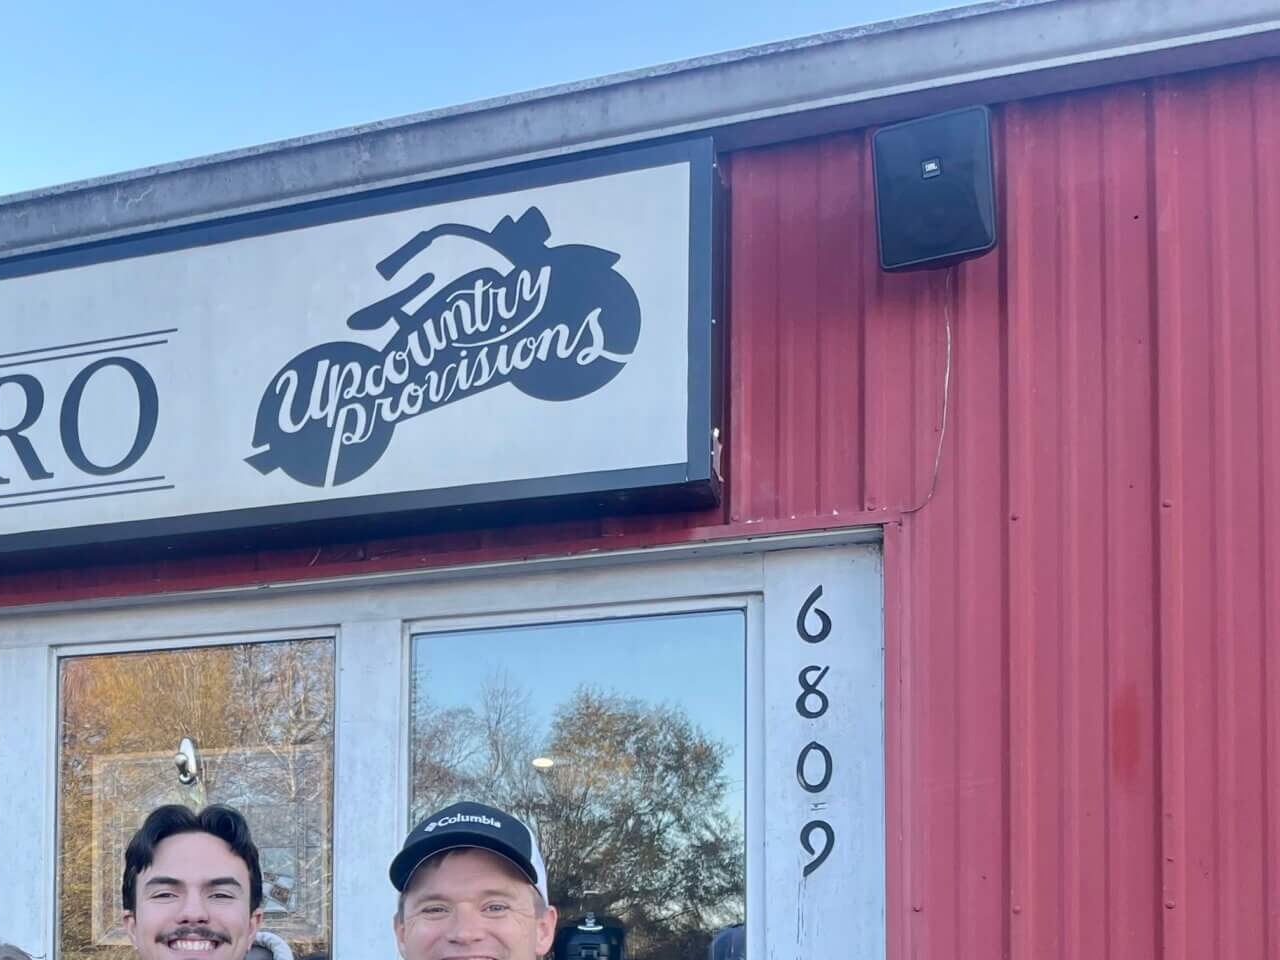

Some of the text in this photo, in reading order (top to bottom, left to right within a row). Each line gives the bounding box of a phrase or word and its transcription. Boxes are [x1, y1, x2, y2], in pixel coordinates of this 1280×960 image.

[276, 265, 552, 433] Upcountry
[795, 584, 836, 877] 6809
[438, 813, 502, 829] Columbia
